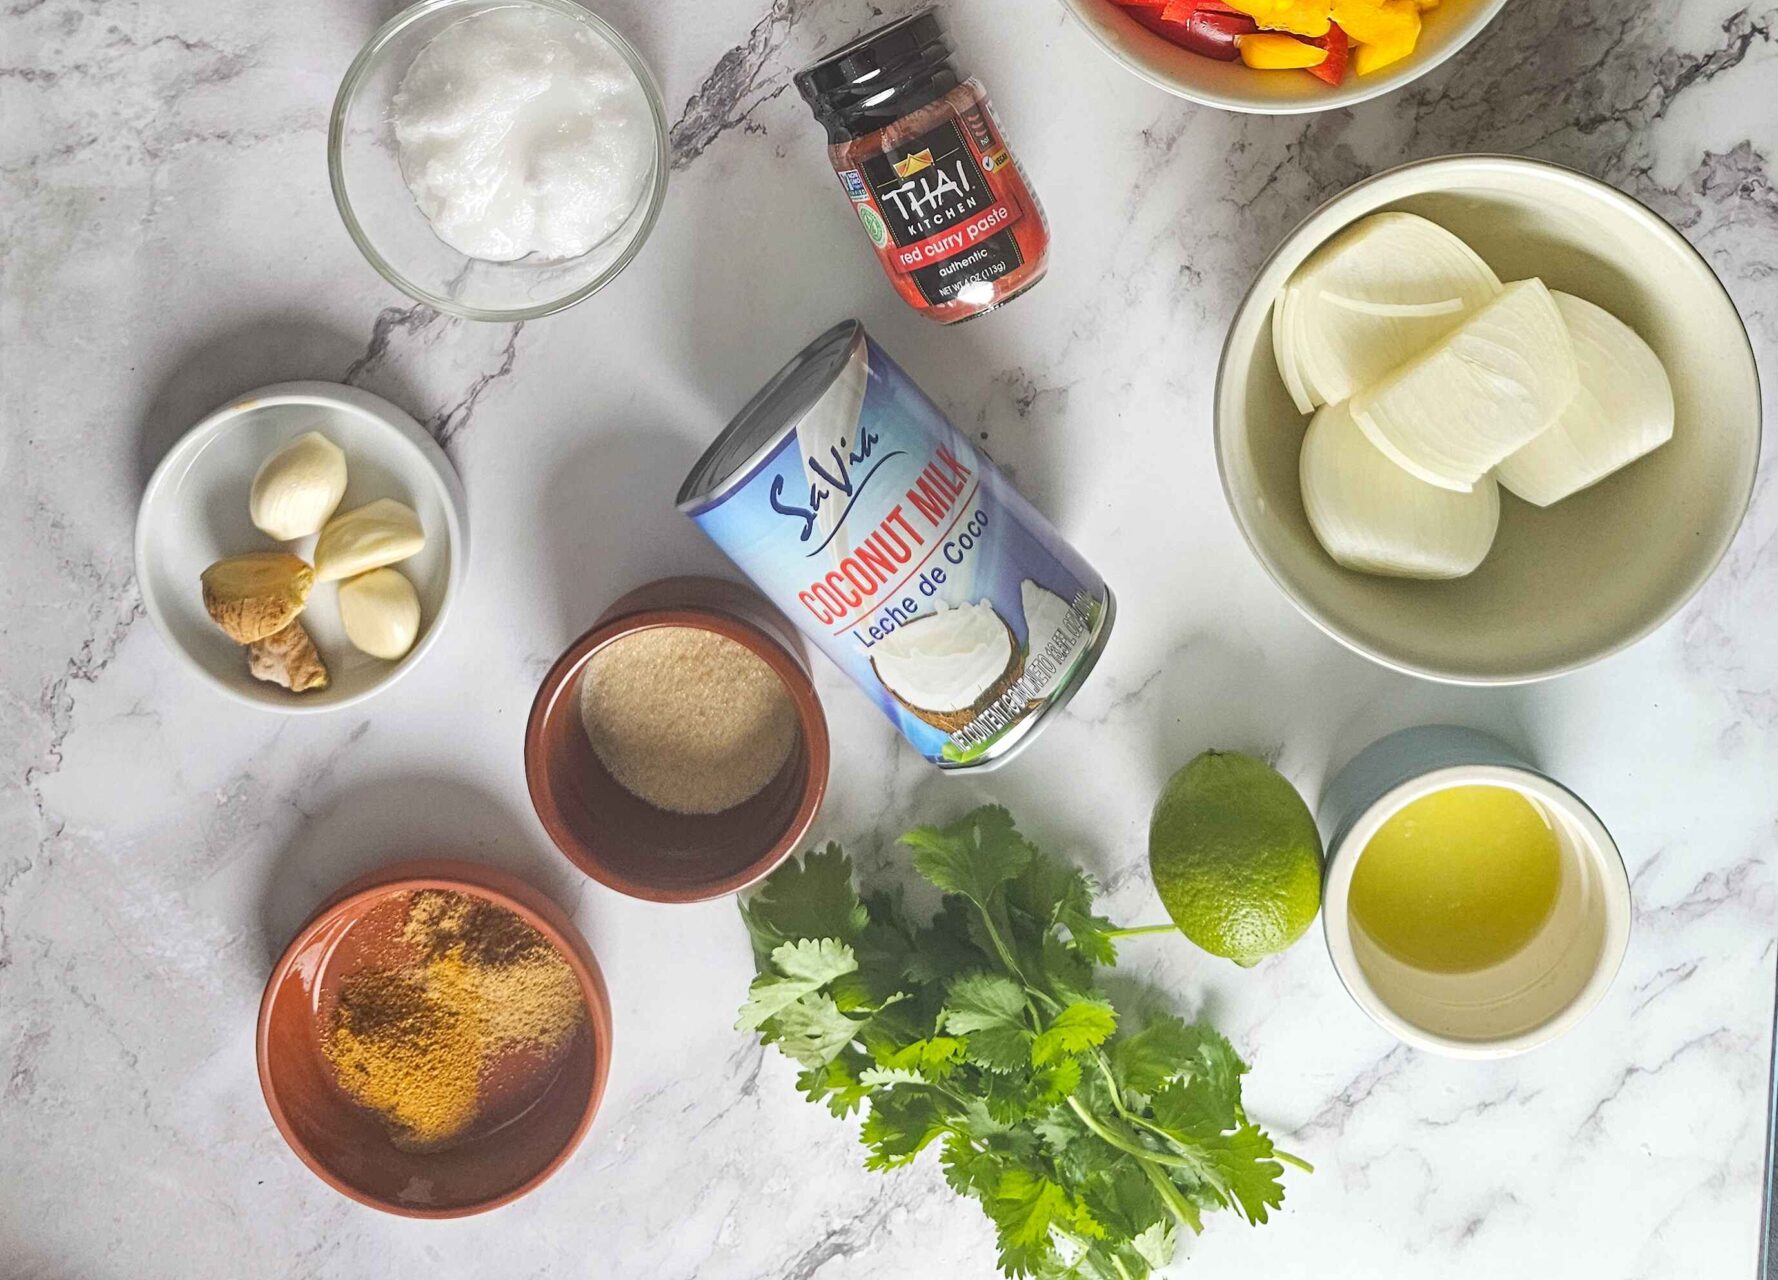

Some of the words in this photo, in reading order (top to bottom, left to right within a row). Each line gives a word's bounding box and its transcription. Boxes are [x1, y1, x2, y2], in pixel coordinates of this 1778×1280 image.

[881, 160, 970, 220] THAI
[899, 246, 923, 266] red
[924, 230, 964, 256] curry
[965, 206, 1008, 240] paste
[907, 196, 977, 236] KITCHEN
[938, 249, 988, 278] authentic
[938, 286, 953, 297] NET
[969, 272, 982, 283] OZ
[981, 261, 1007, 280] (113g)
[798, 504, 925, 625] COCONUT
[905, 441, 971, 527] MILK
[852, 597, 918, 648] Leche
[919, 566, 947, 597] de
[943, 509, 989, 565] Coco
[950, 728, 974, 752] NET
